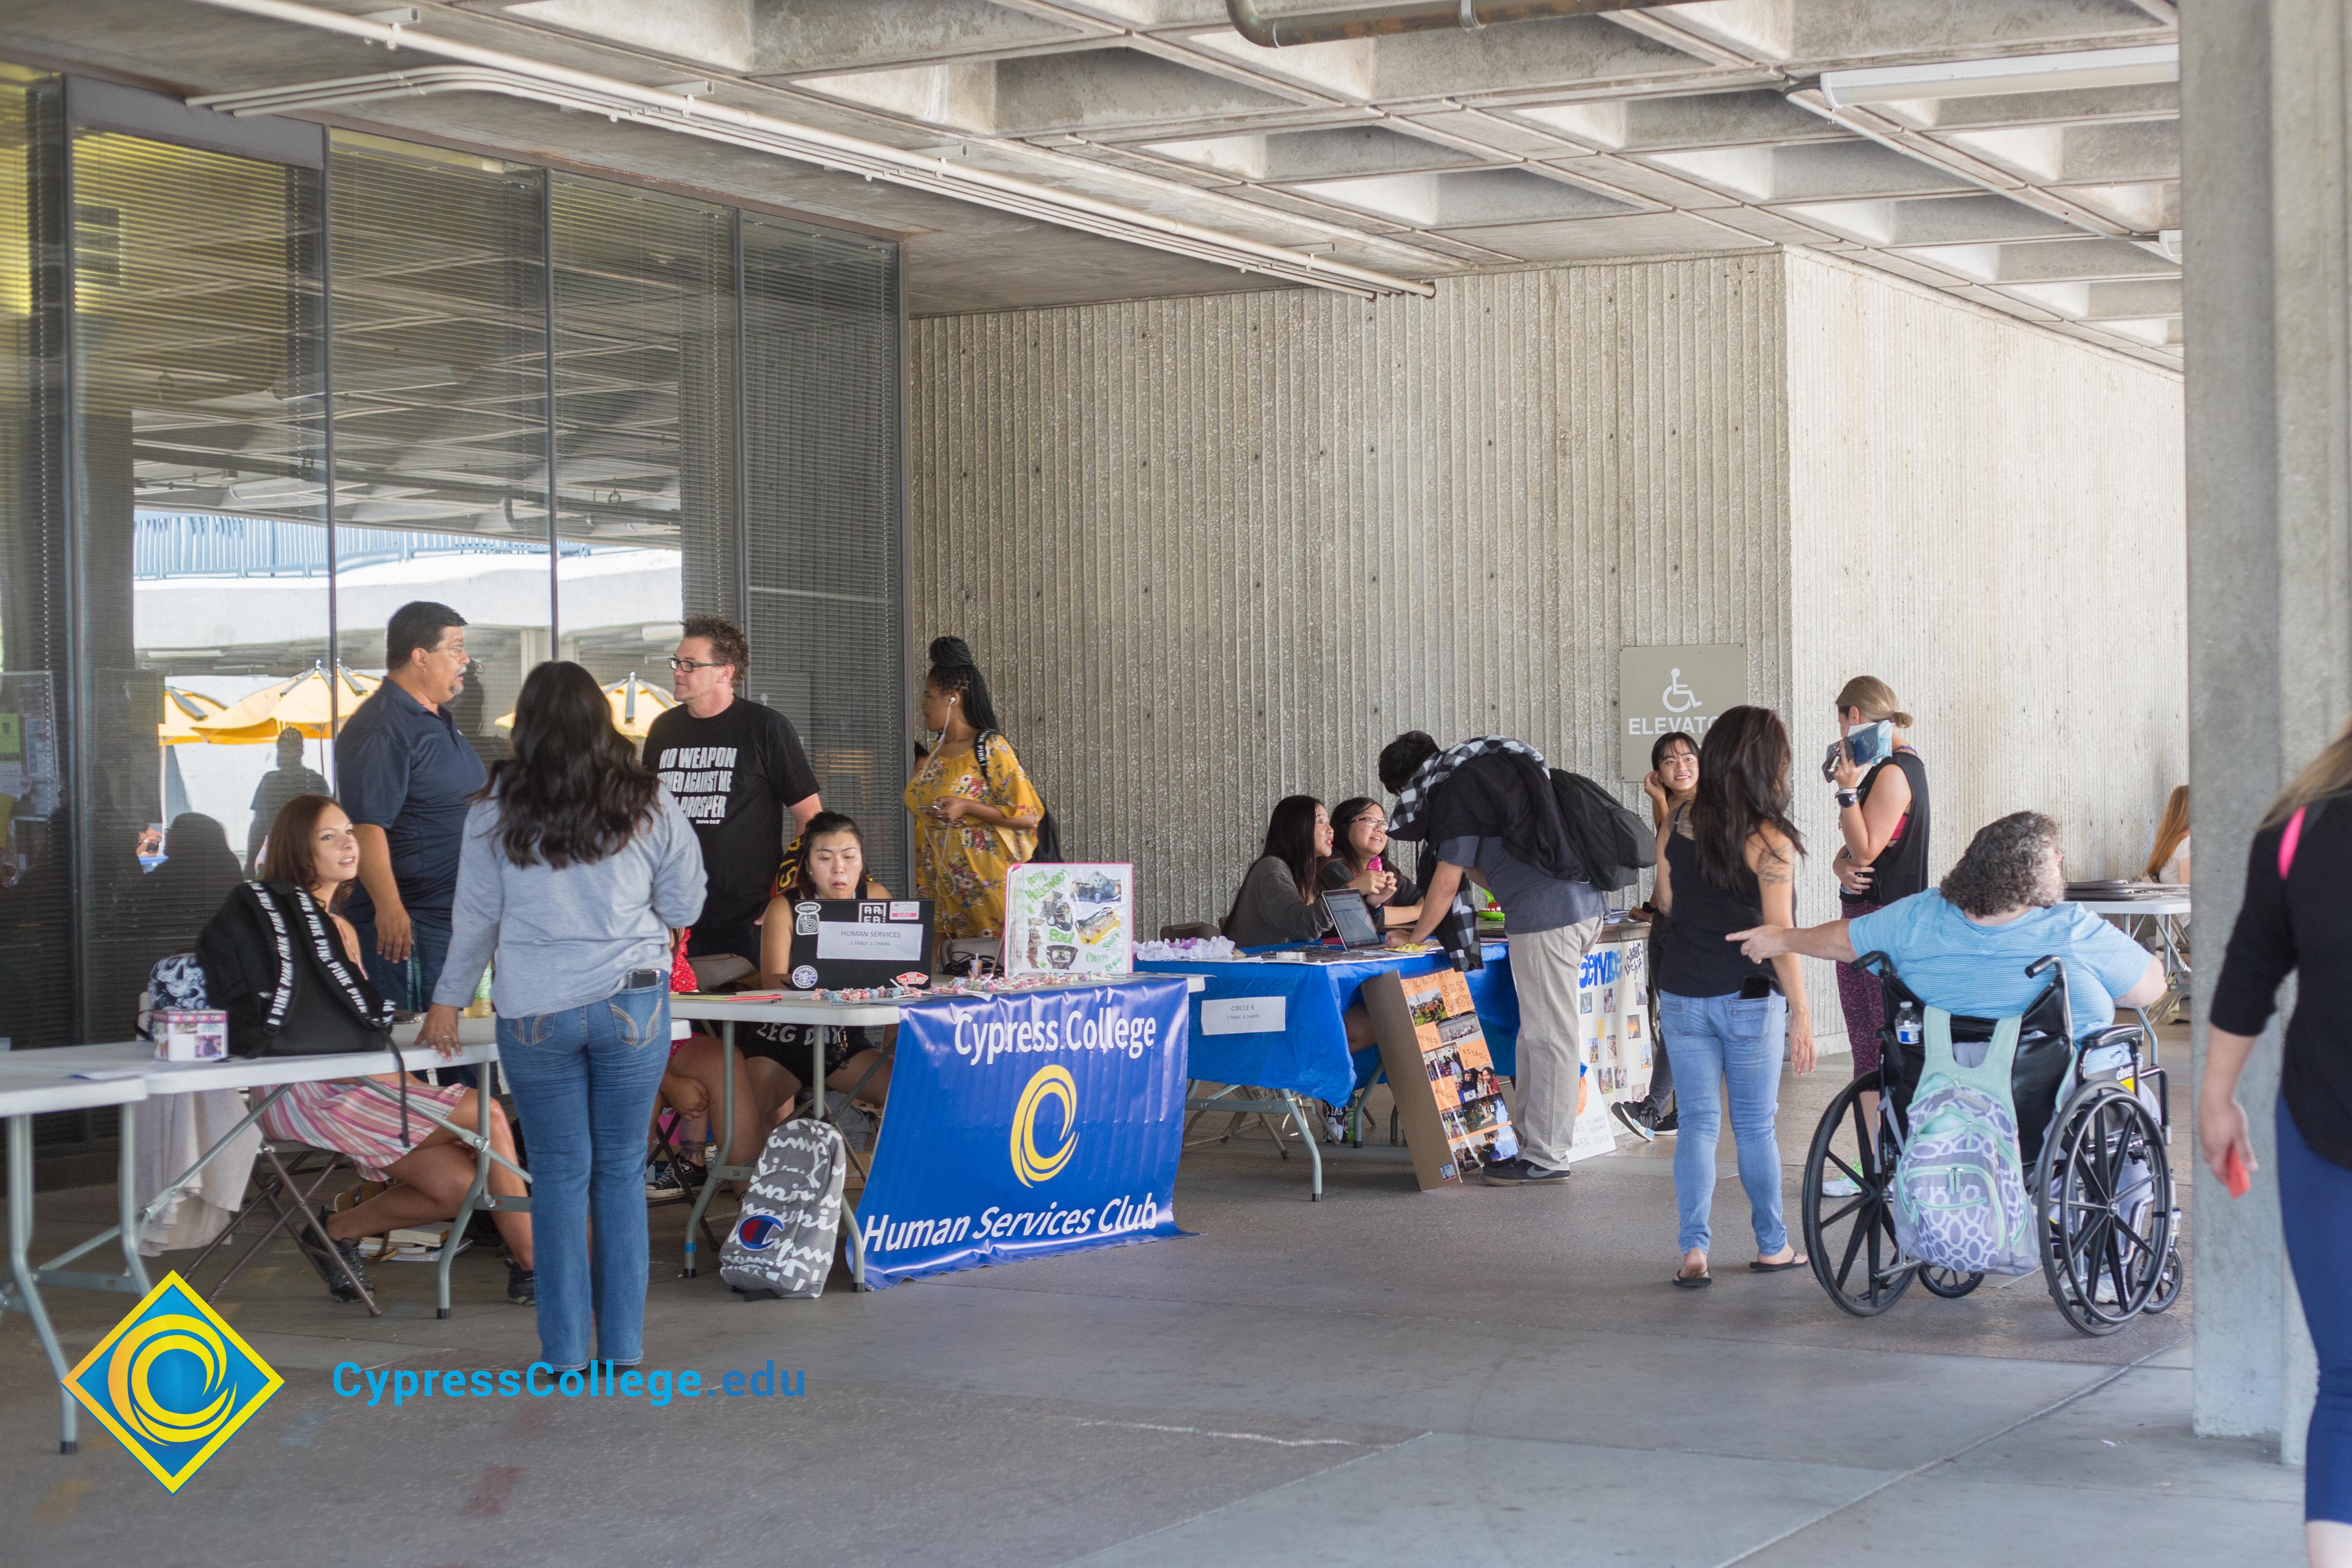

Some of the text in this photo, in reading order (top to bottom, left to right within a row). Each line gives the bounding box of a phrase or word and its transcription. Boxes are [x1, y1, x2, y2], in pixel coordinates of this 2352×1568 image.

[1628, 715, 1720, 736] ELEVATO
[659, 747, 738, 769] NO WEAPON
[683, 771, 719, 793] AGAINST
[718, 770, 733, 792] ME
[681, 795, 727, 818] PROSPER
[306, 915, 325, 937] PINK
[327, 961, 354, 987] PINK
[271, 987, 291, 1016] PINK
[954, 1007, 1157, 1066] Cypress College
[862, 1215, 972, 1252] Human
[972, 1201, 1097, 1240] Services
[1097, 1192, 1157, 1233] Club
